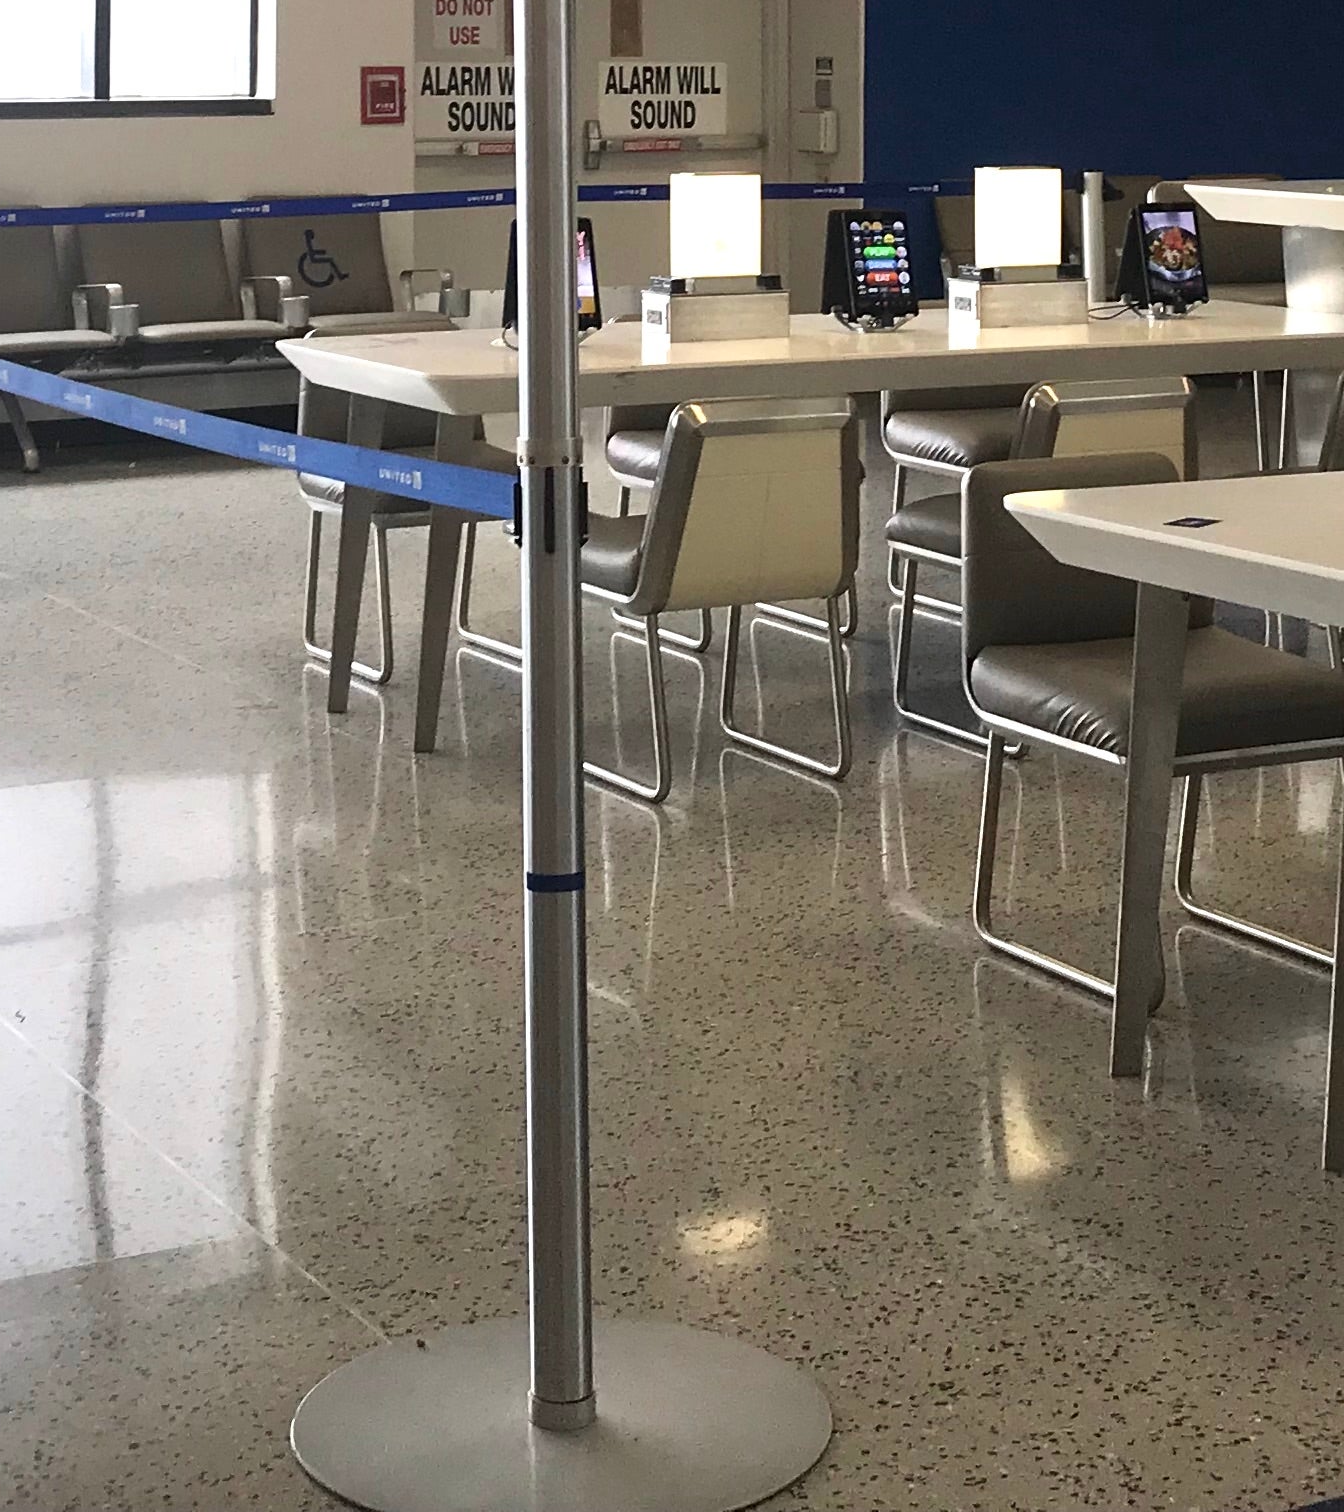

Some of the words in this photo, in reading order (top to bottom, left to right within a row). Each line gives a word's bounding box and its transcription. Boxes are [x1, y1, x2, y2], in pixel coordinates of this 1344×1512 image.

[449, 27, 481, 46] USE
[420, 66, 491, 96] ALARM
[605, 67, 671, 95] ALARM
[676, 65, 721, 95] WILL
[448, 102, 515, 132] SOUND
[630, 101, 696, 130] SOUND
[258, 442, 288, 458] UNITED
[379, 467, 412, 485] UNITED
